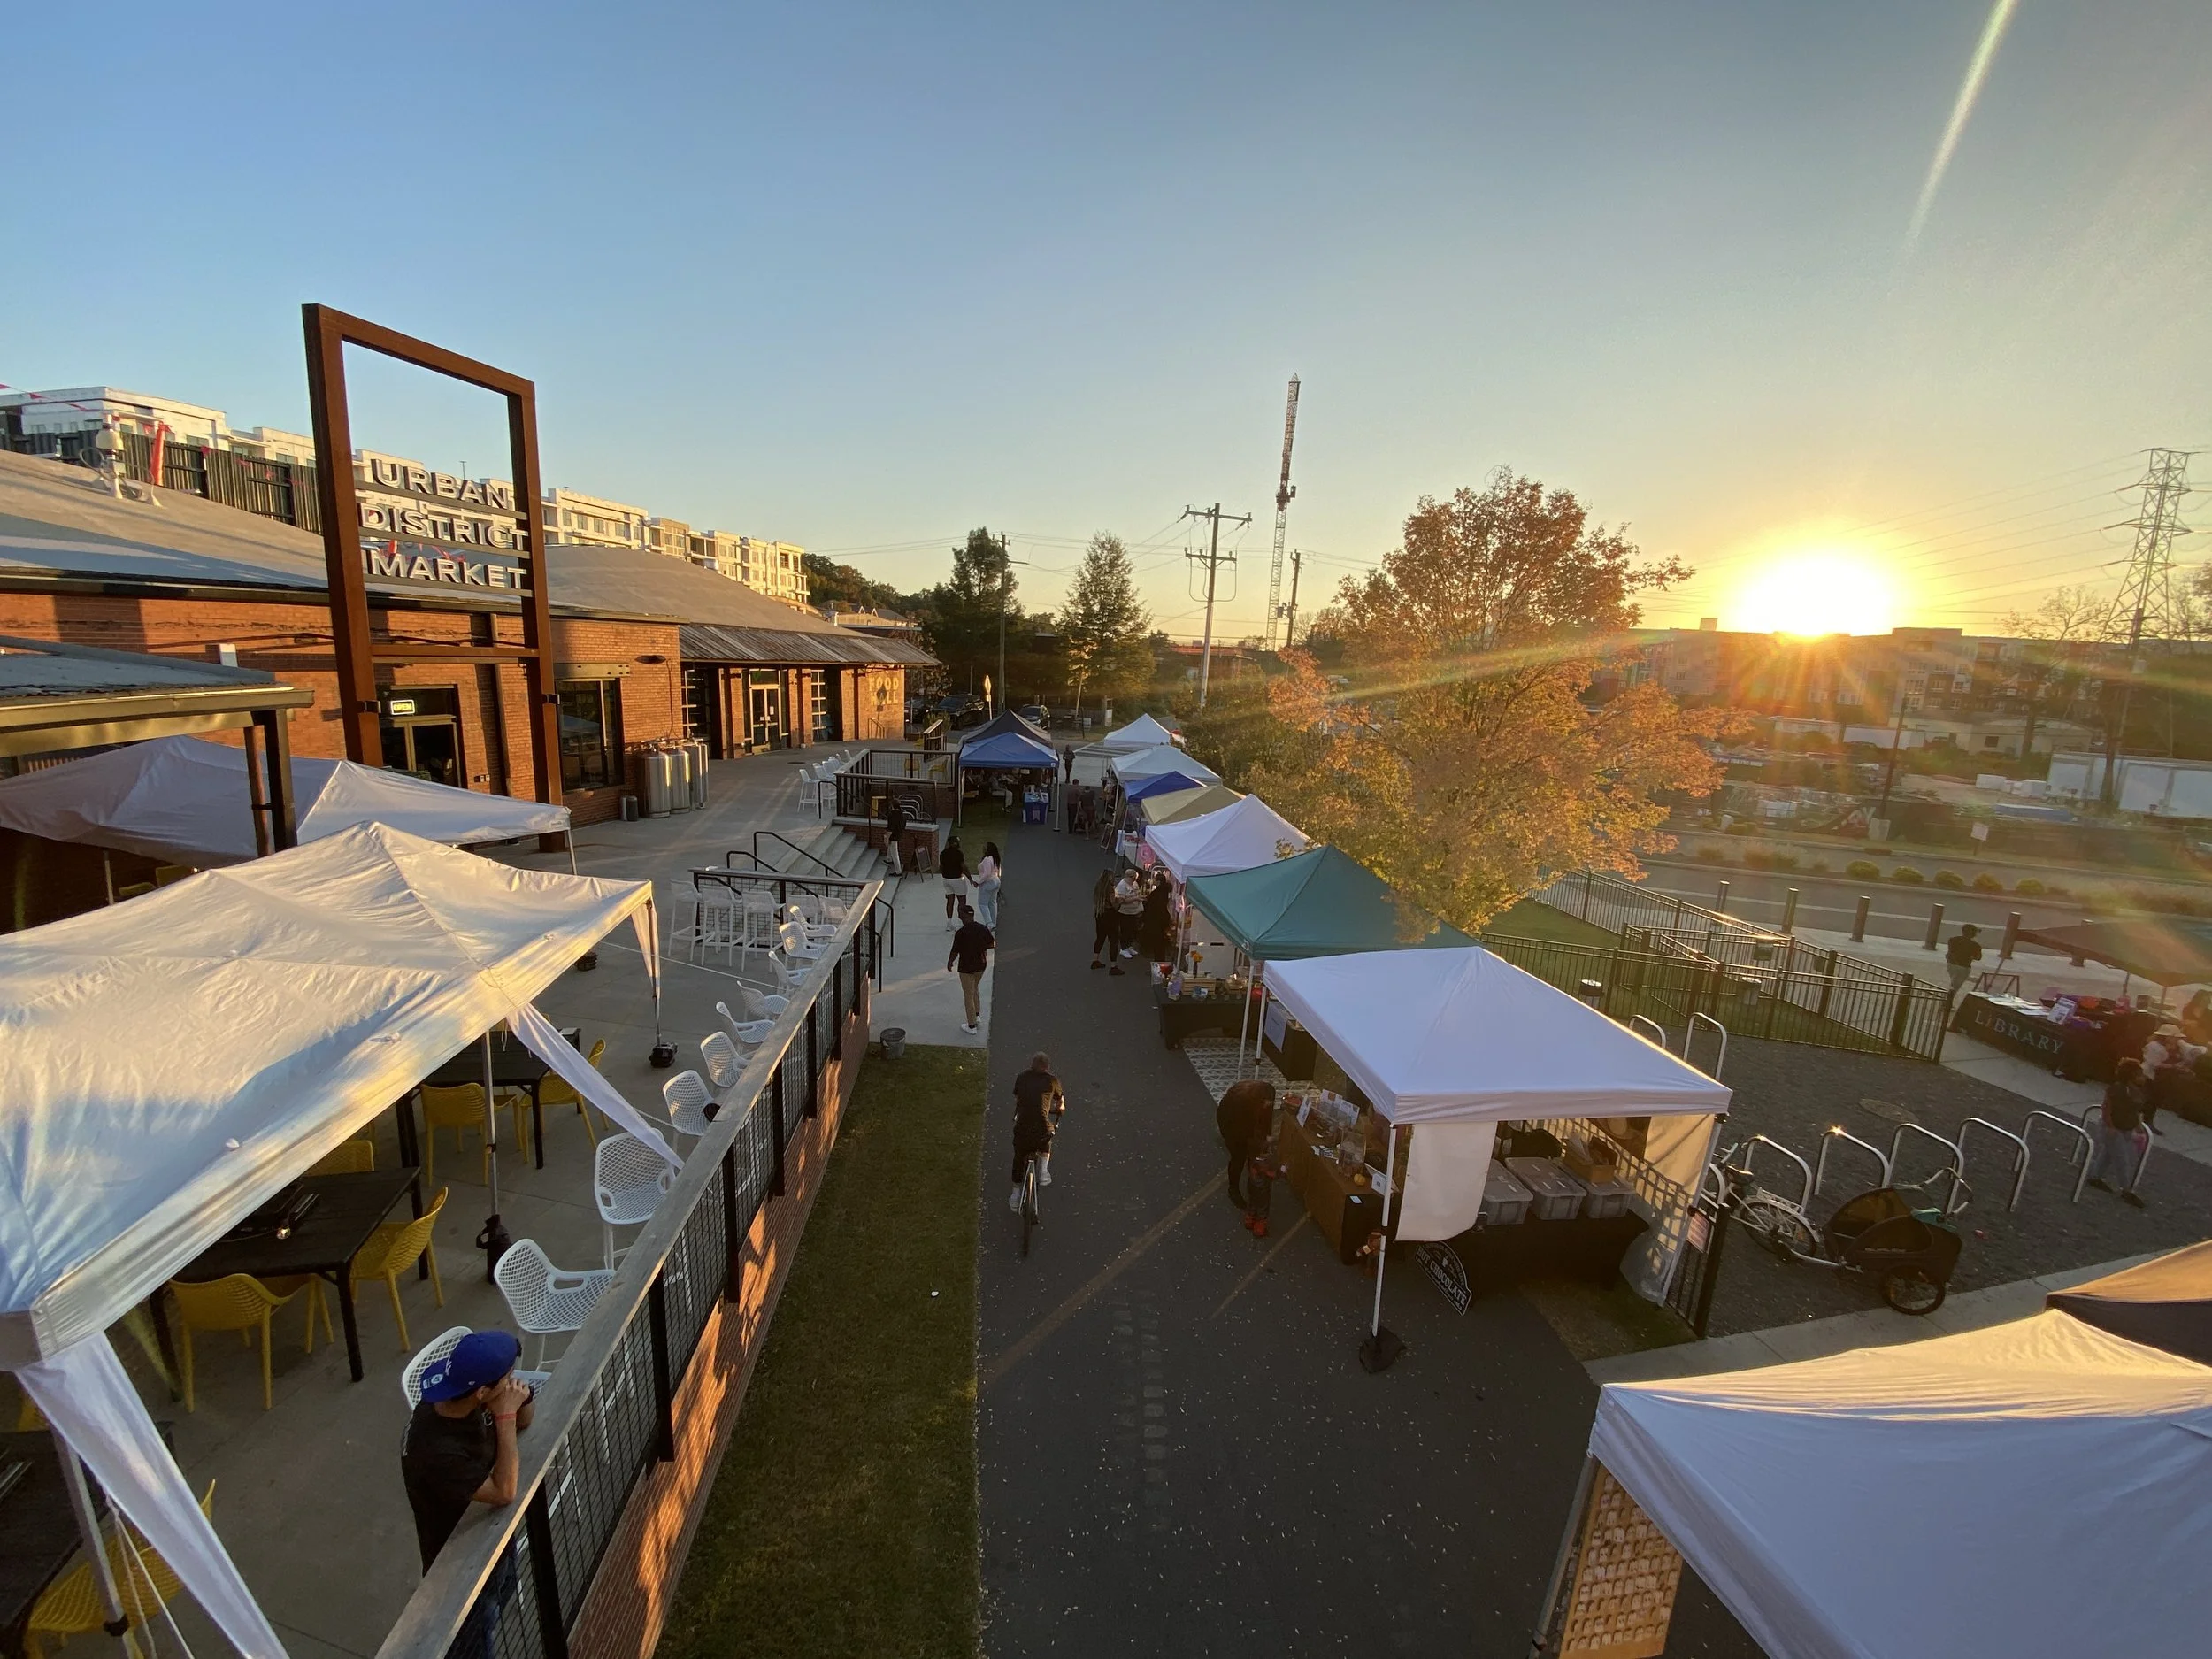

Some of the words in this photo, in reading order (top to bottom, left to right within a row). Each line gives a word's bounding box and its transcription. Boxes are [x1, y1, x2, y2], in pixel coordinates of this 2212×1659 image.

[371, 458, 509, 509] URBAN
[357, 502, 528, 551] DISTRICT
[365, 549, 526, 589] MARKET
[869, 676, 899, 691] FOOD
[1430, 1259, 1467, 1306] CHOCOLATE
